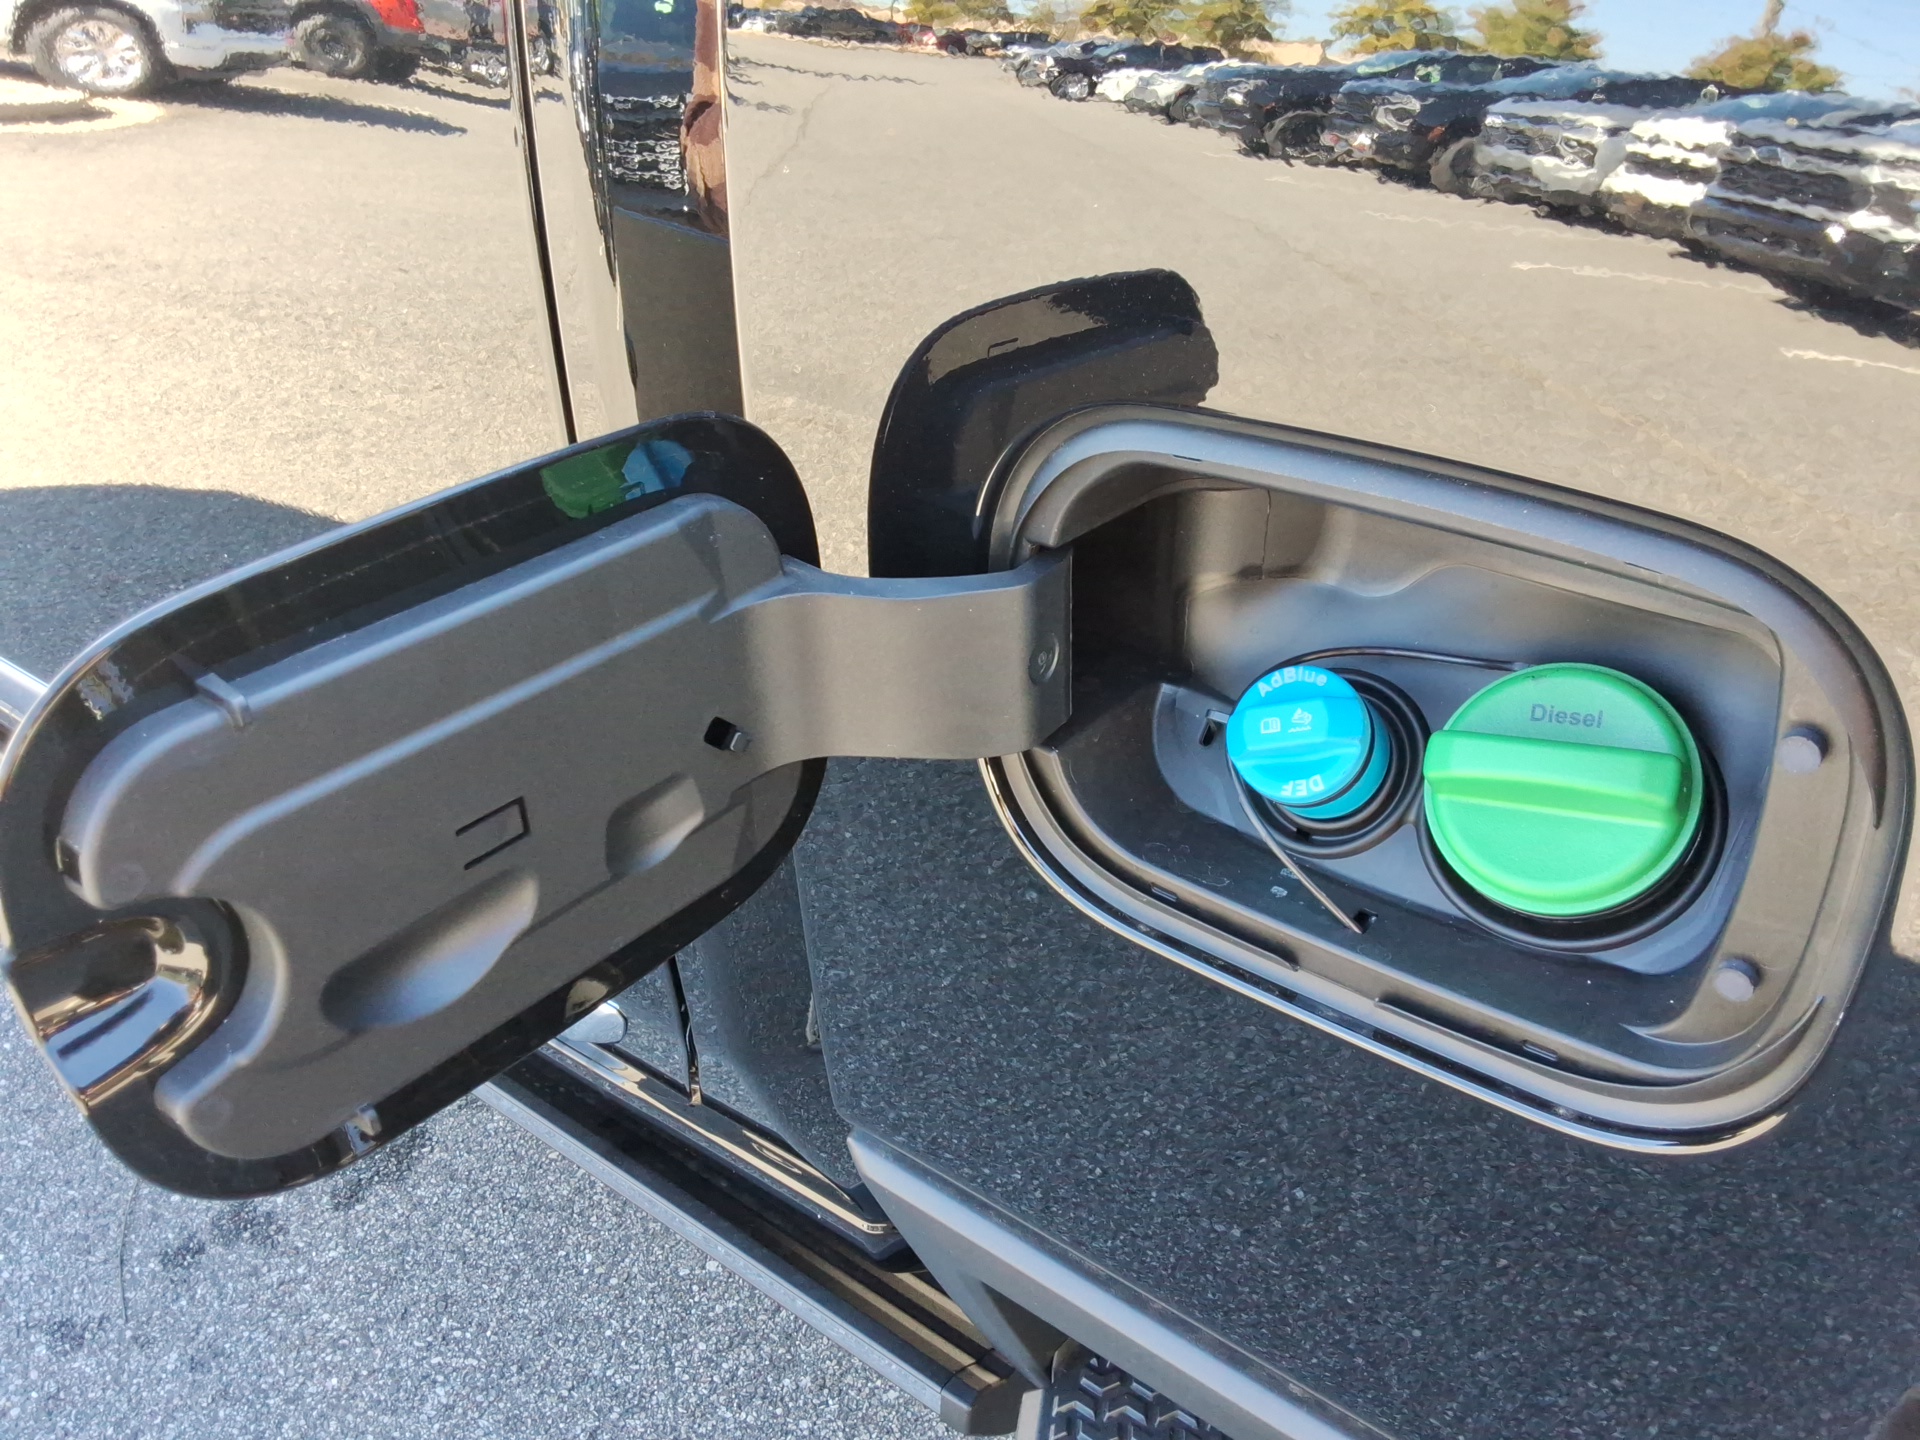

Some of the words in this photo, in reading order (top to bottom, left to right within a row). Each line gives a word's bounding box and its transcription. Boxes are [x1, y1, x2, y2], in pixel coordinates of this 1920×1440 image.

[1257, 666, 1328, 698] AdBlue
[1529, 703, 1604, 729] Diesel
[1281, 774, 1325, 797] DEF
